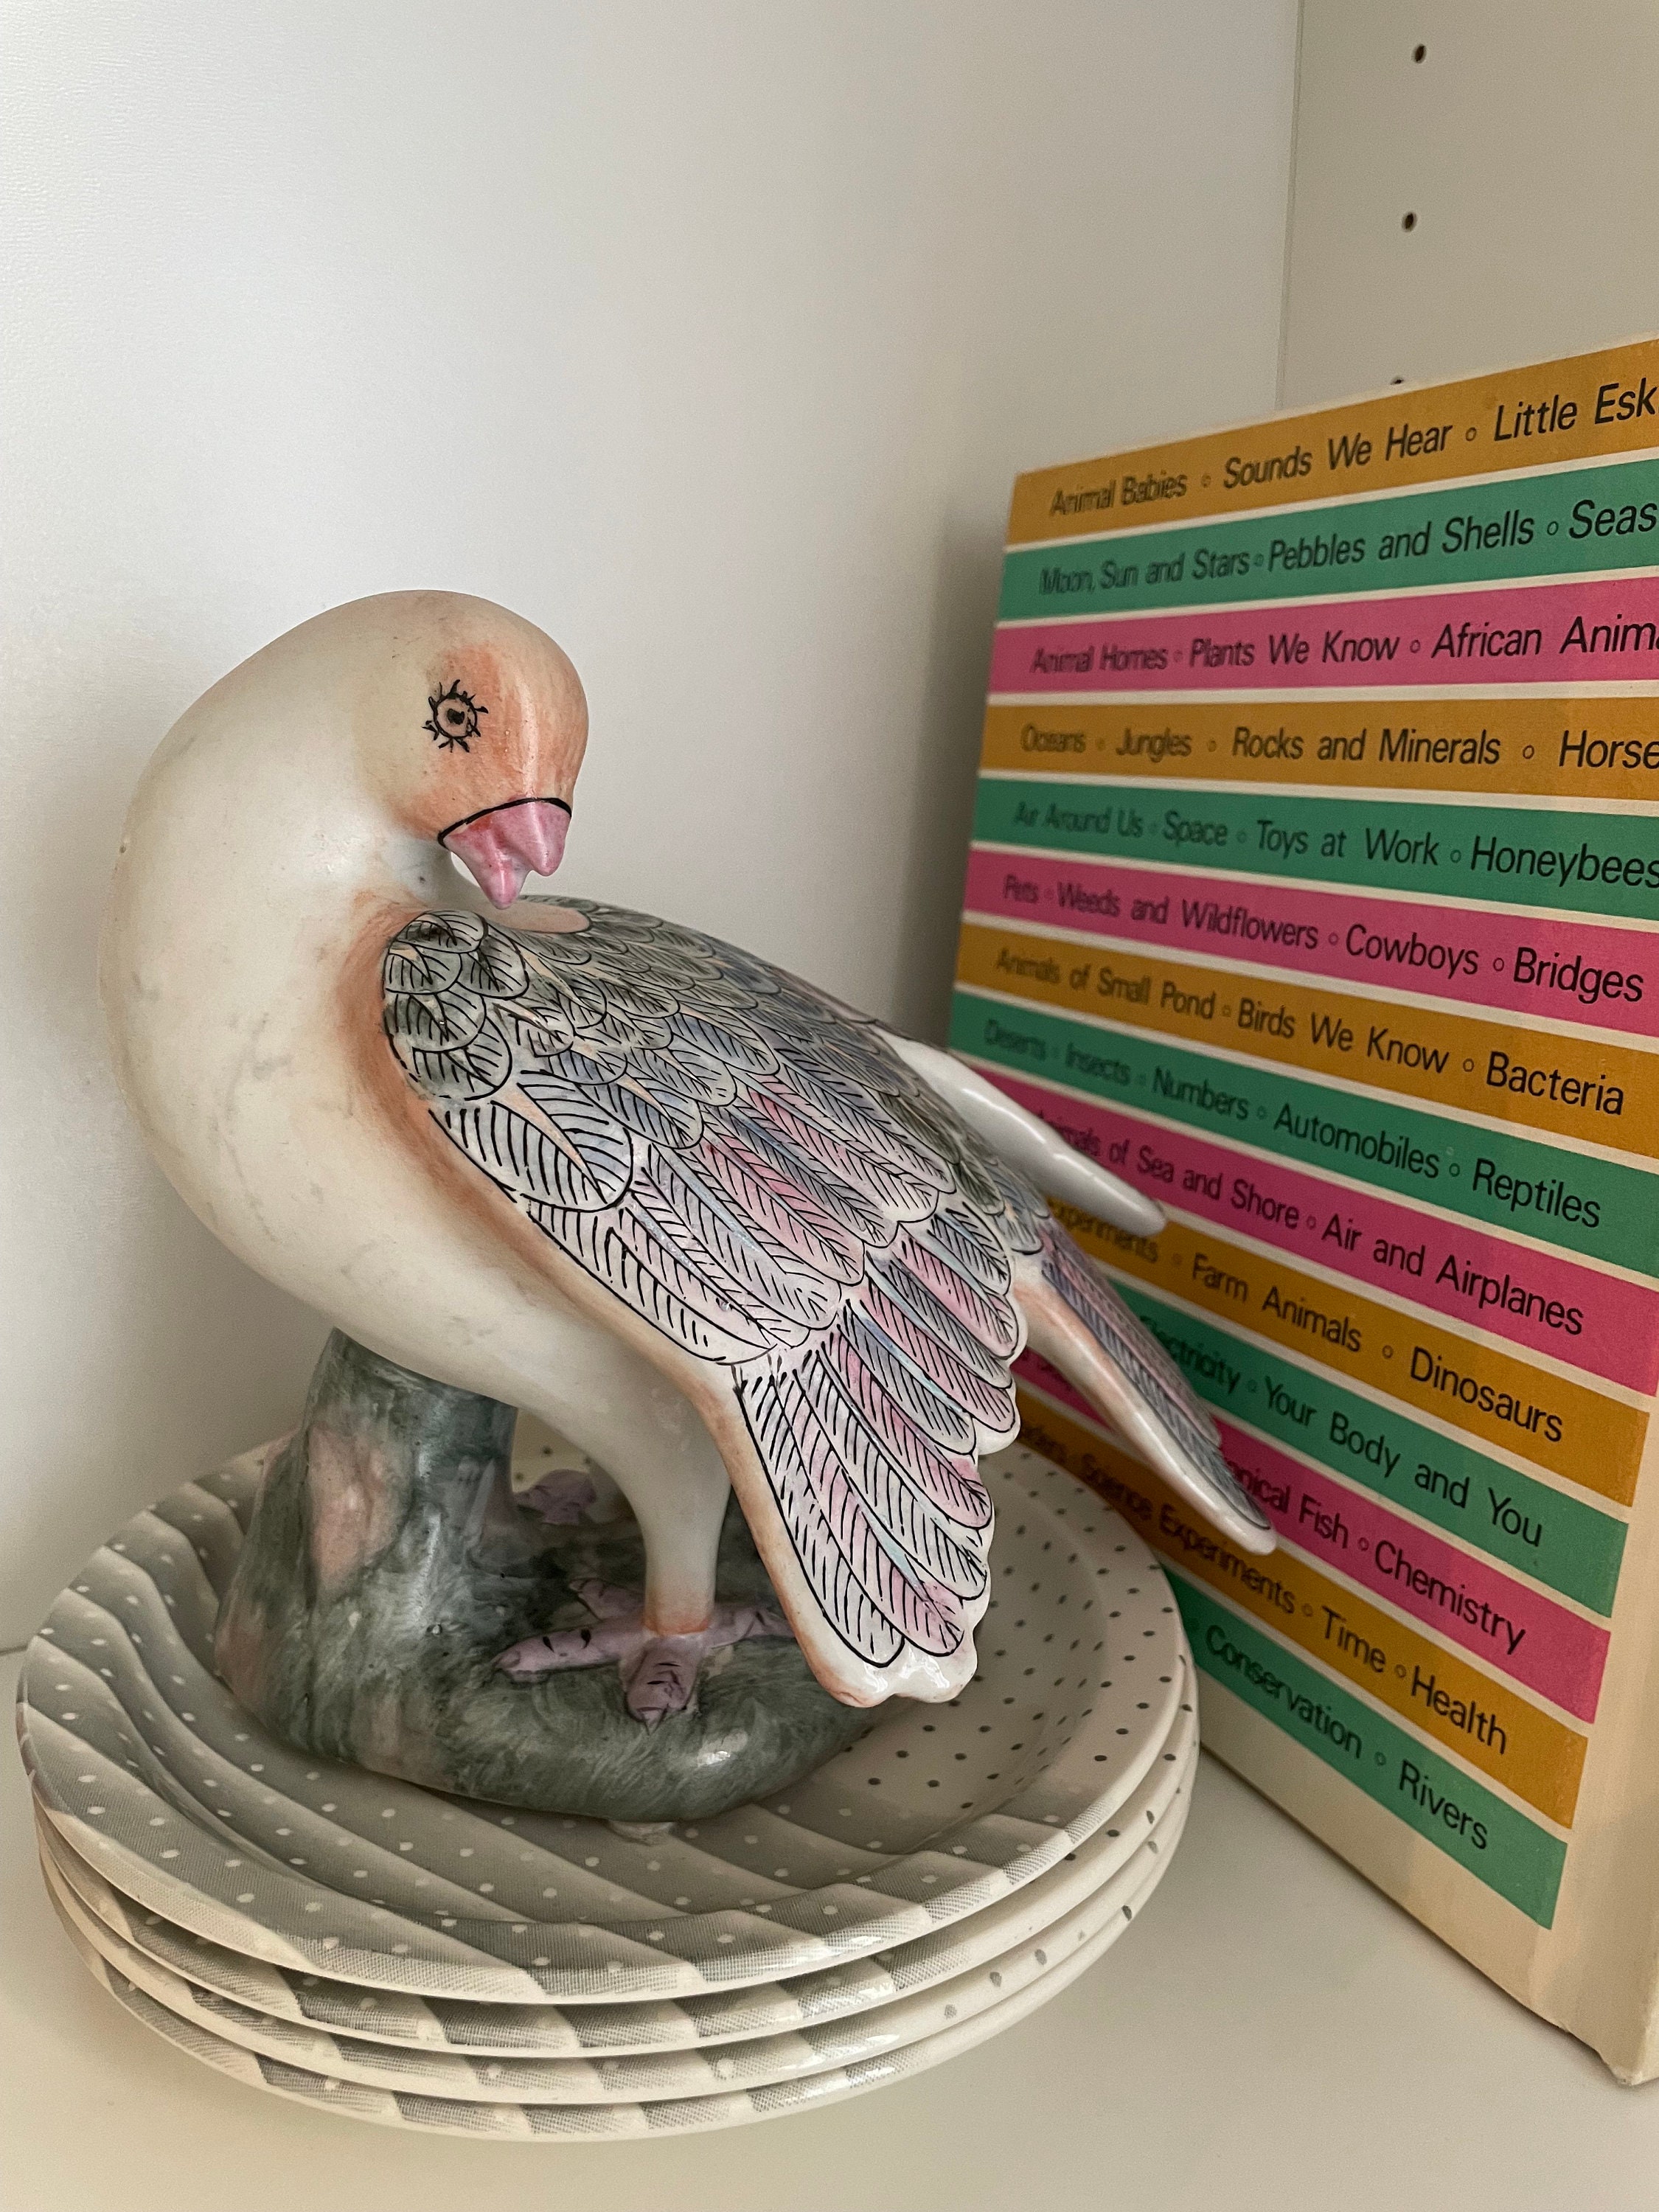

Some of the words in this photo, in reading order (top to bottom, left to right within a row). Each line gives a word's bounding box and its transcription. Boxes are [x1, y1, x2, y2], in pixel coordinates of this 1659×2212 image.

[1050, 480, 1114, 515] Animal
[1121, 470, 1186, 505] Babies
[1223, 446, 1312, 489] Sounds
[1329, 433, 1371, 470] We
[1385, 421, 1453, 462] Hear
[1493, 394, 1577, 442] Little
[1594, 377, 1659, 425] Esk
[1100, 559, 1138, 590] Sun
[1144, 552, 1185, 585] and
[1192, 547, 1251, 581] Stars
[1267, 532, 1365, 573] Pebbles
[1378, 521, 1430, 560] and
[1442, 509, 1535, 554] Shells
[1568, 499, 1658, 539] Seas
[1029, 644, 1094, 675] Animal
[1099, 640, 1169, 672] Homes
[1189, 637, 1255, 667] Plants
[1268, 633, 1310, 665] We
[1323, 629, 1399, 664] Know
[1431, 621, 1542, 658] African
[1559, 613, 1659, 654] Anim
[1115, 726, 1193, 762] Jungles
[1231, 727, 1304, 759] Rocks
[1318, 730, 1366, 761] and
[1379, 728, 1500, 764] Minerals
[1559, 730, 1659, 769] Horse
[1043, 803, 1112, 834] Around
[1116, 809, 1142, 838] Us
[1163, 811, 1227, 847] Space
[1256, 820, 1308, 858] Toys
[1321, 831, 1347, 858] at
[1364, 828, 1439, 867] Work
[1470, 835, 1659, 888] Honeybees
[1057, 881, 1120, 917] Weeds
[1130, 896, 1170, 924] and
[1180, 899, 1319, 950] Wildflowers
[1345, 924, 1479, 979] Cowboys
[1513, 947, 1644, 1004] Bridges
[997, 948, 1060, 984] Animals
[1070, 964, 1091, 990] of
[1097, 967, 1150, 1004] Small
[1160, 980, 1215, 1020] Pond
[1237, 998, 1296, 1040] Birds
[1310, 1012, 1355, 1053] We
[1366, 1026, 1450, 1077] Know
[1486, 1051, 1626, 1118] Bacteria
[1066, 1042, 1130, 1087] Insects
[1152, 1066, 1251, 1122] Numbers
[1273, 1103, 1441, 1180] Automobiles
[1472, 1158, 1601, 1228] Reptiles
[1108, 1139, 1130, 1165] of
[1137, 1145, 1174, 1183] Sea
[1183, 1169, 1223, 1200] and
[1231, 1183, 1300, 1230] Shore
[1321, 1213, 1363, 1251] Air
[1373, 1231, 1425, 1277] and
[1436, 1256, 1585, 1336] Airplanes
[1192, 1252, 1249, 1303] Farm
[1262, 1285, 1363, 1353] Animals
[1409, 1346, 1565, 1444] Dinosaurs
[1264, 1376, 1318, 1428] Your
[1329, 1410, 1402, 1478] Body
[1414, 1463, 1470, 1509] and
[1485, 1487, 1543, 1548] You
[1159, 1503, 1295, 1615] Experiments
[1321, 1604, 1386, 1673] Time
[1411, 1666, 1509, 1755] Health
[1298, 1493, 1351, 1550] Fish
[1374, 1540, 1527, 1656] Chemistry
[1205, 1622, 1363, 1760] Conservation
[1399, 1759, 1489, 1851] Rivers
